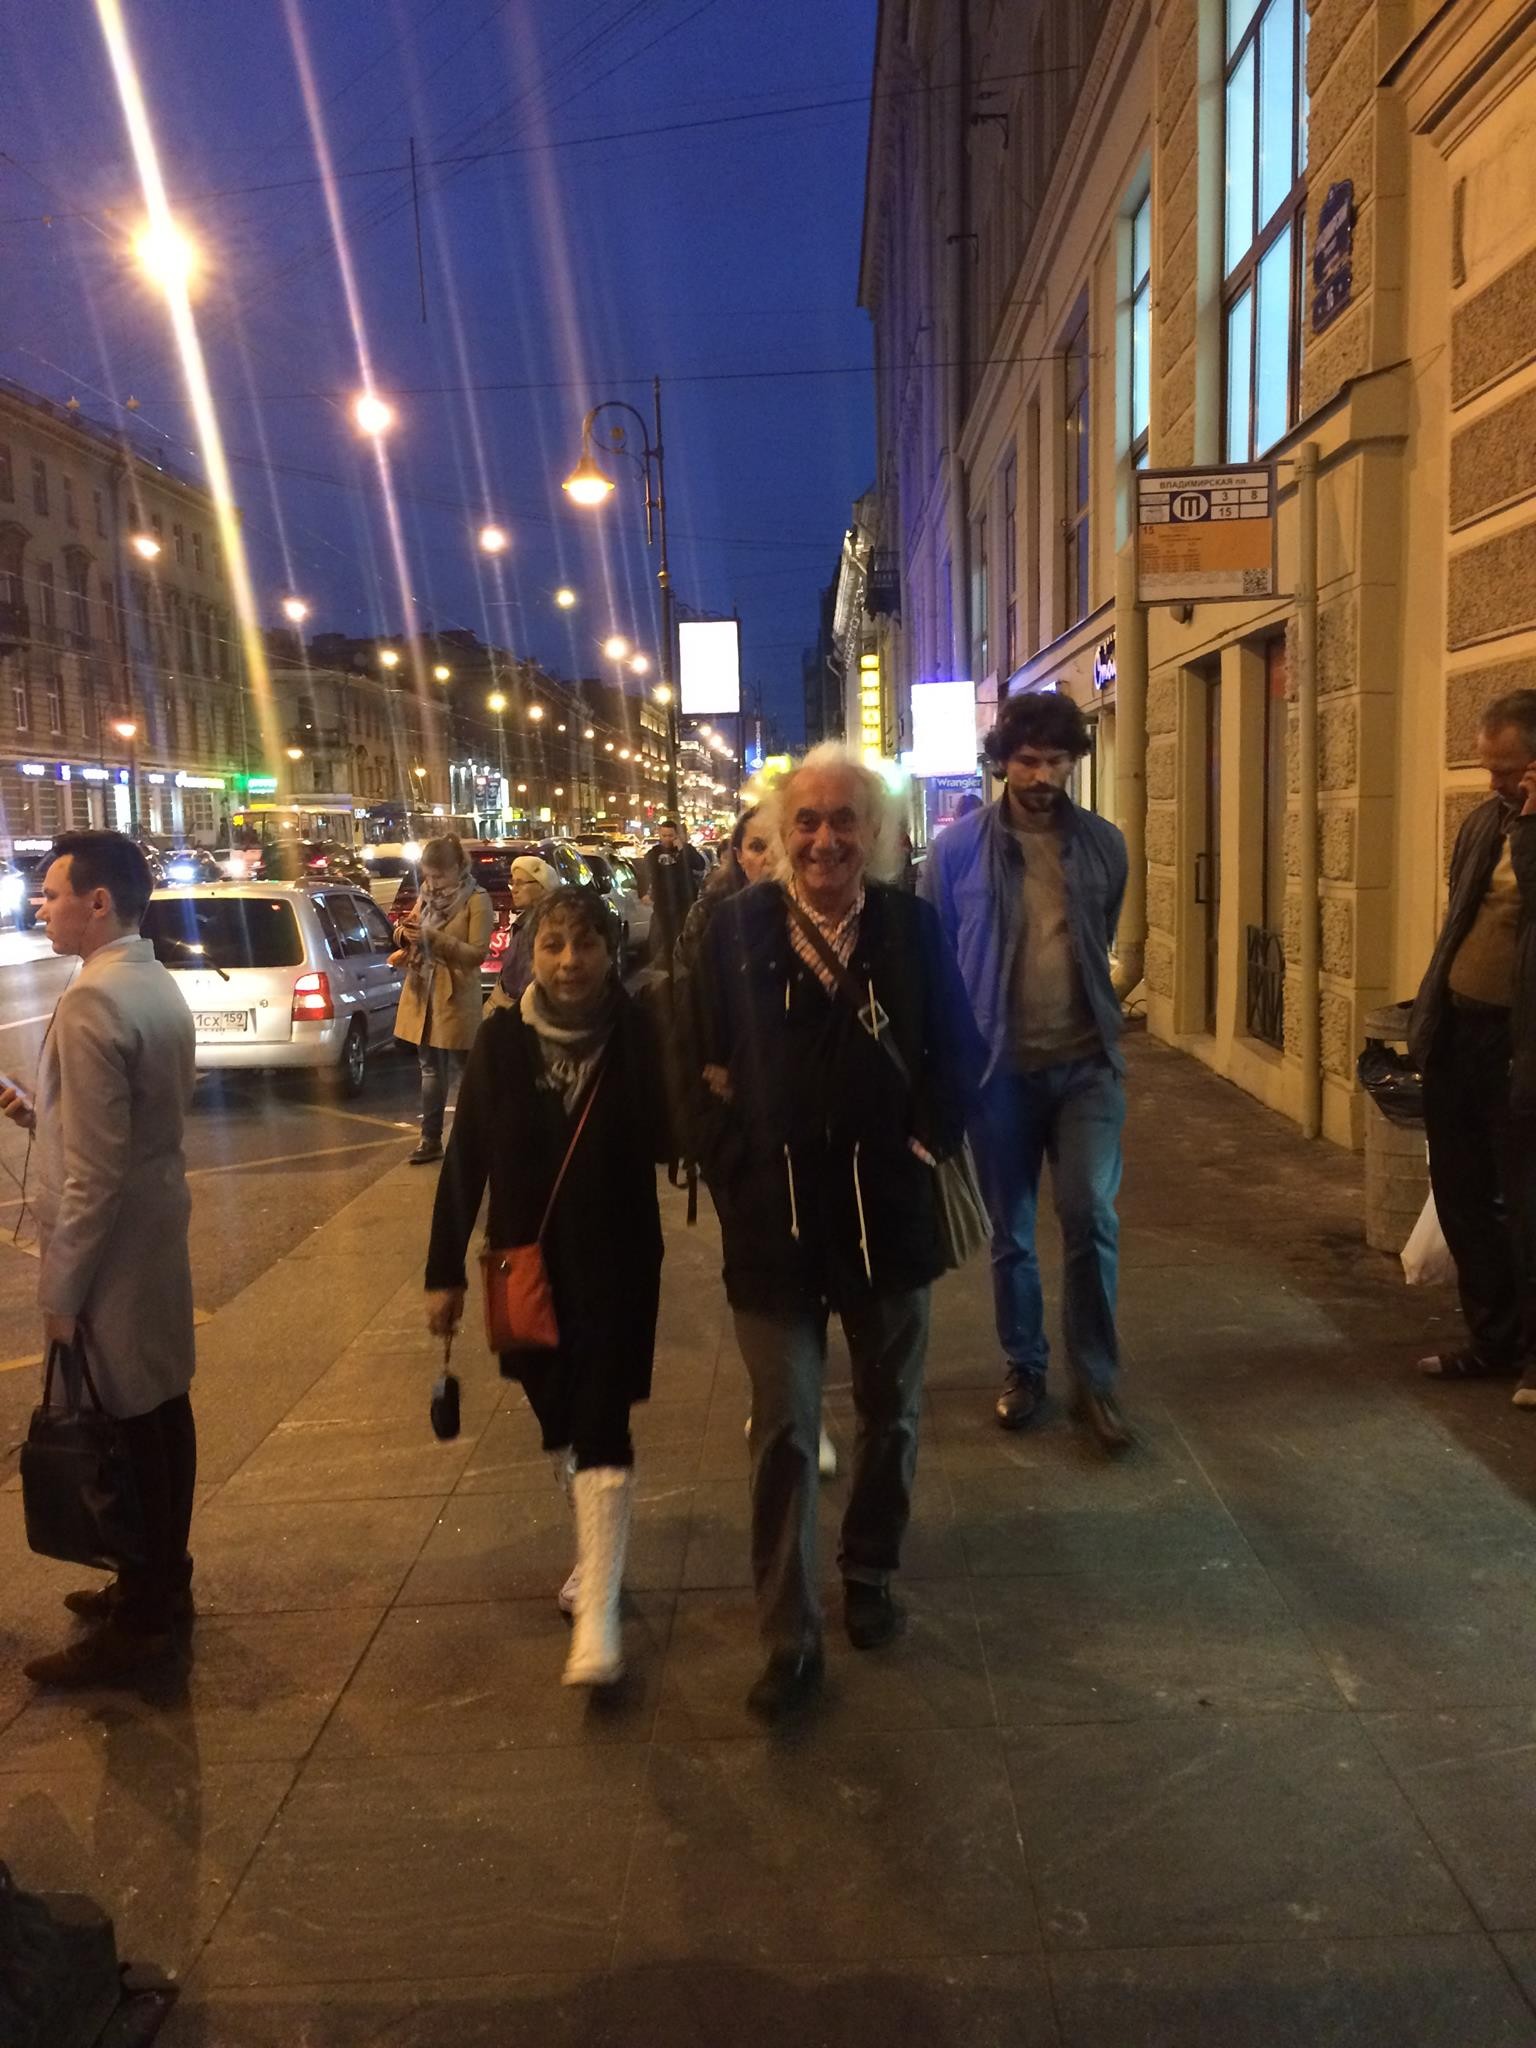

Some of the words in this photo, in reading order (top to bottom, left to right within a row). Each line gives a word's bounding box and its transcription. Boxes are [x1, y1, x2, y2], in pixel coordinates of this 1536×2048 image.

[1160, 478, 1233, 489] ВЛАДИМИРСКАЯ
[1222, 491, 1229, 501] 3
[1251, 490, 1258, 500] 8
[1220, 507, 1232, 517] 15
[1142, 525, 1154, 535] 15
[936, 777, 981, 789] Wrangler
[224, 1013, 243, 1023] 159
